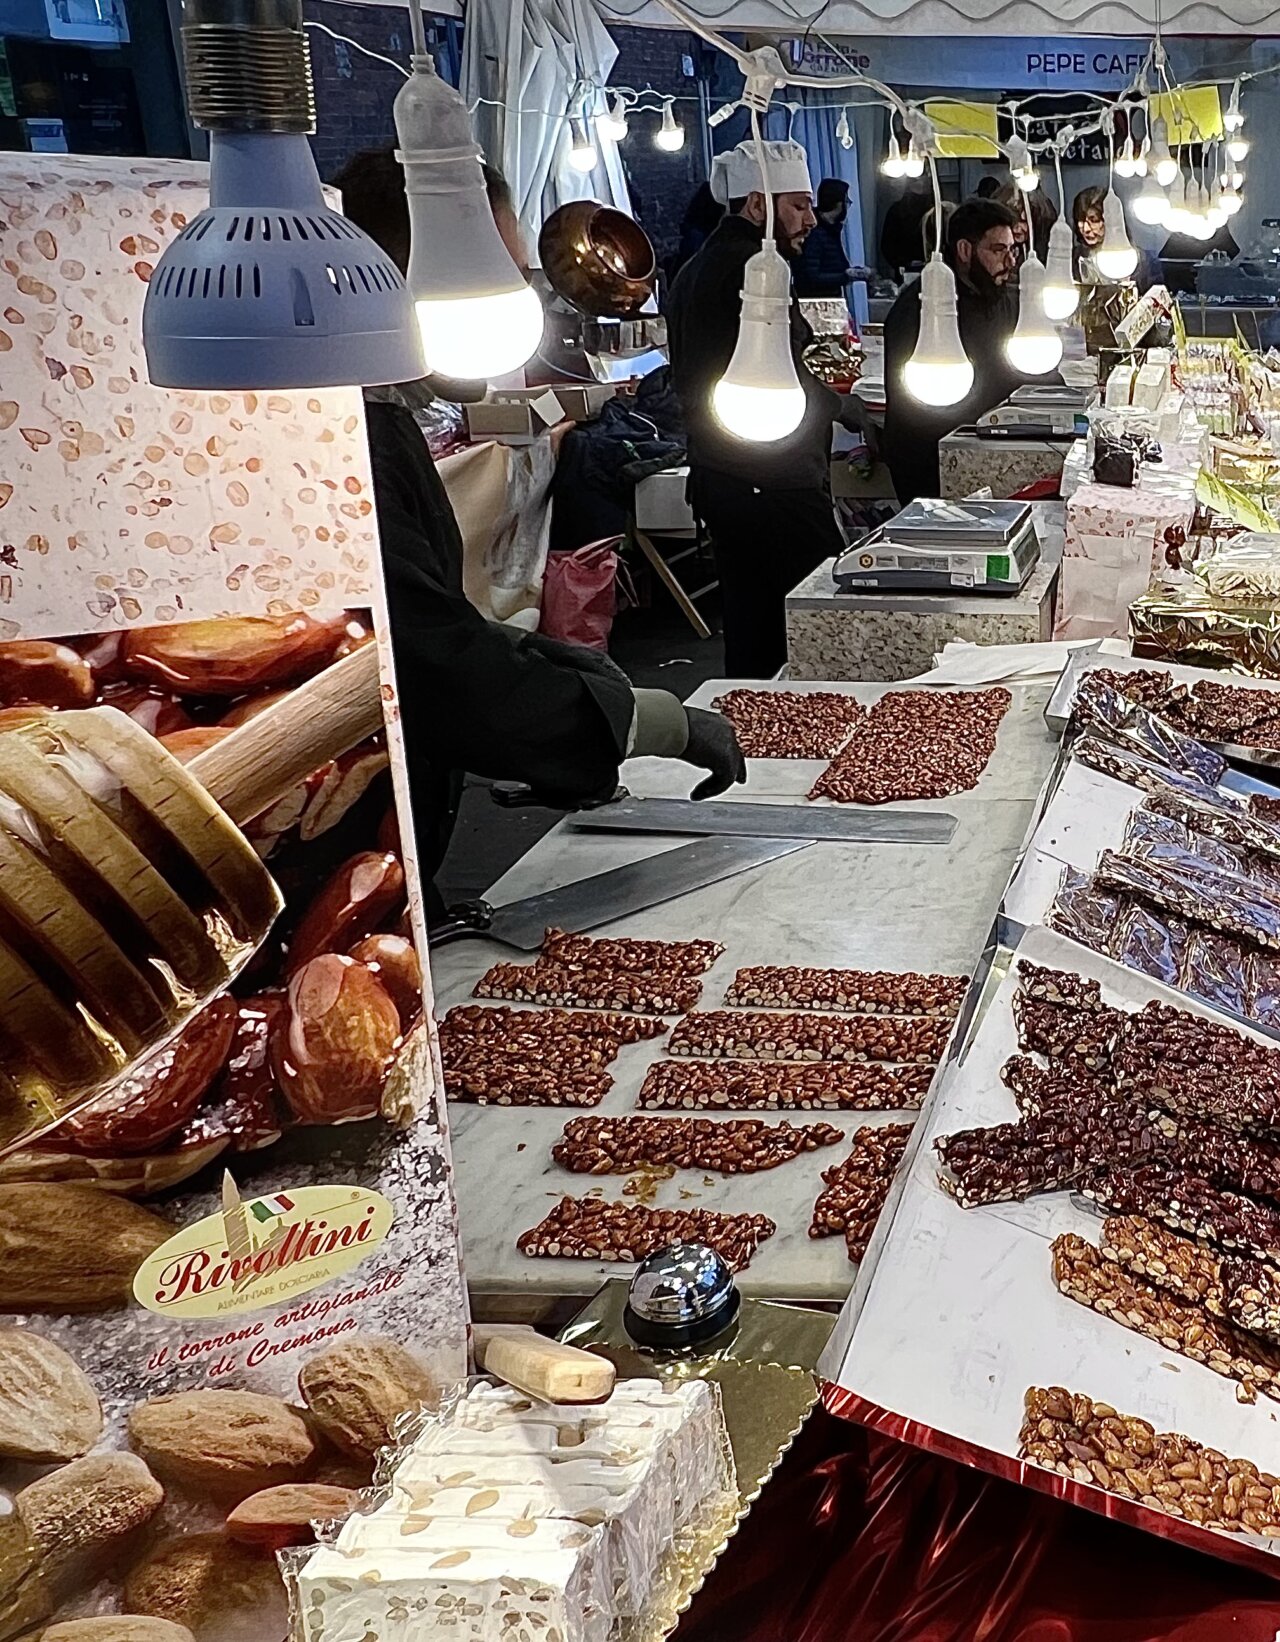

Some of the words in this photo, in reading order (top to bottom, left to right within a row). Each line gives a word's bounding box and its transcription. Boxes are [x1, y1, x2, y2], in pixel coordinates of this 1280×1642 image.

[1027, 53, 1086, 74] PEPE
[154, 1206, 376, 1303] Rivoltini
[148, 1346, 171, 1371] il
[178, 1321, 264, 1361] torrone
[274, 1269, 405, 1328] artigianale
[216, 1285, 275, 1312] ALIMENTARE
[278, 1268, 330, 1292] DOLCIARIA
[208, 1358, 236, 1387] di
[246, 1317, 358, 1368] Cremona
